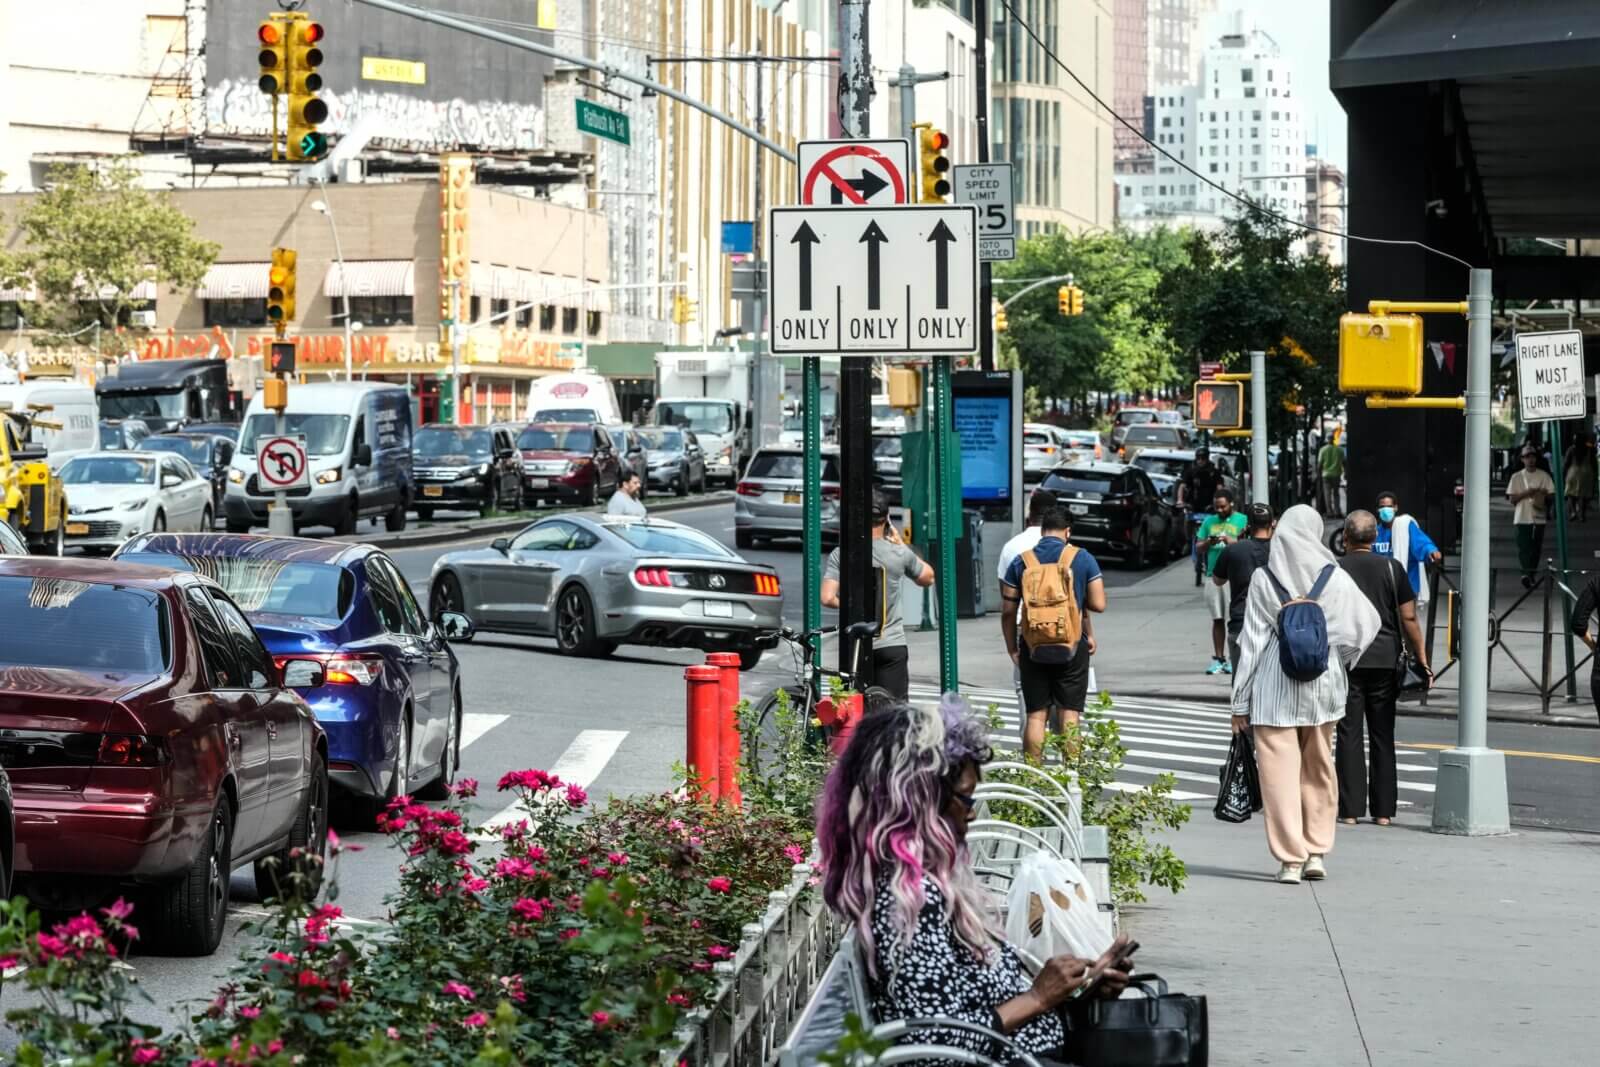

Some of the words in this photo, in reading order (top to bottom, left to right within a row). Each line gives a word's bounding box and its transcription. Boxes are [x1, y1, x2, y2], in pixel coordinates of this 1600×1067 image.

[970, 169, 994, 178] CITY
[965, 180, 1000, 189] SPEED
[969, 192, 996, 201] LIMIT
[979, 249, 1010, 258] ORCED
[980, 241, 1000, 249] OTO
[782, 318, 830, 340] ONLY
[850, 317, 898, 340] ONLY
[918, 317, 966, 339] ONLY
[396, 342, 440, 363] BAR
[1521, 344, 1550, 360] RIGHT
[1554, 342, 1579, 357] LANE
[1535, 367, 1568, 385] MUST
[1524, 394, 1551, 409] TURN
[1554, 392, 1581, 407] RIGHT
